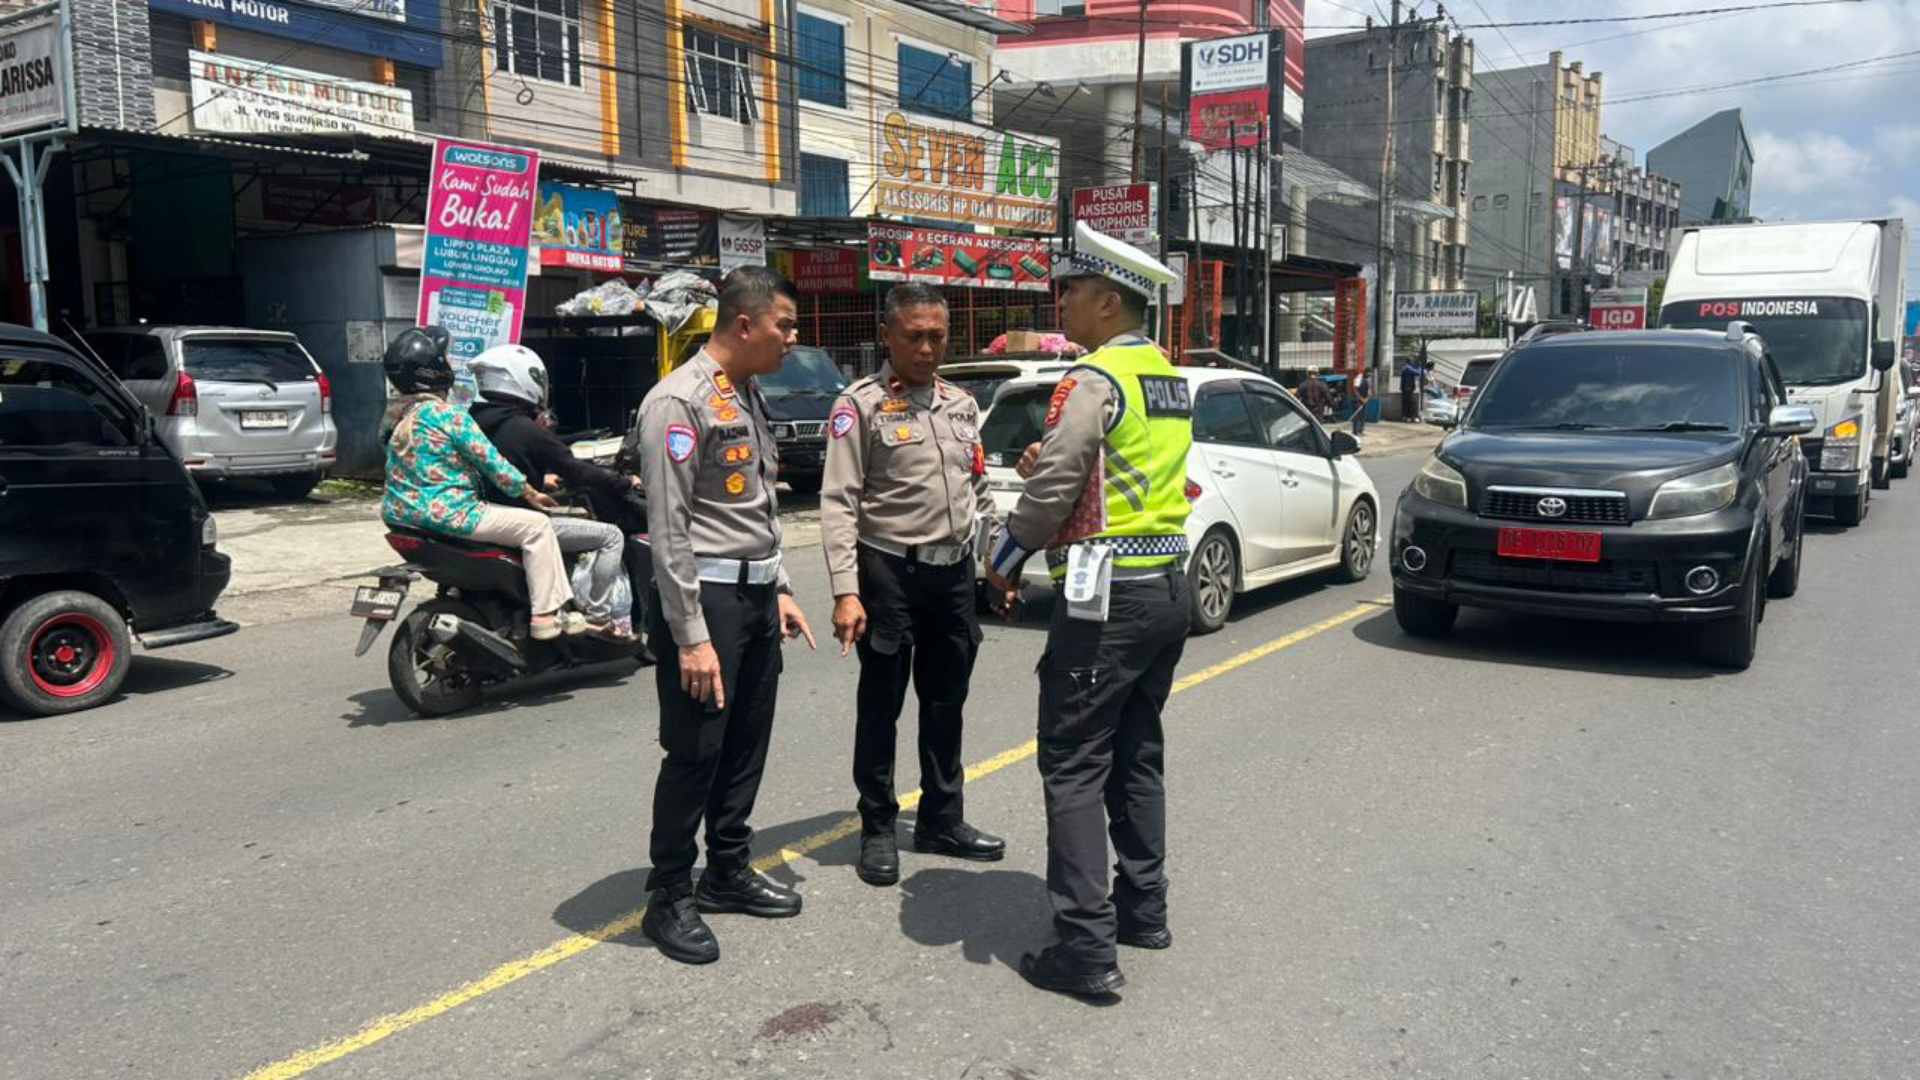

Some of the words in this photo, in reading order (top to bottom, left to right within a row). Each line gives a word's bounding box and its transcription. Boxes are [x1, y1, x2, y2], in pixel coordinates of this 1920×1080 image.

[231, 0, 289, 24] MOTOR
[1218, 42, 1263, 64] SDH
[883, 112, 986, 191] SEVEN
[996, 132, 1054, 200] ACC
[439, 168, 480, 192] Kami
[481, 174, 530, 200] Sudah
[885, 190, 949, 212] AKSESORIS
[953, 198, 967, 214] HP
[1092, 187, 1129, 201] PUSAT
[440, 193, 519, 231] Buka!
[1078, 200, 1145, 217] AKSESORIS
[1088, 214, 1148, 229] NDPHONE
[868, 227, 914, 241] GROSIR
[927, 232, 973, 248] ECERAN
[476, 242, 511, 256] PLAZA
[471, 251, 519, 267] LINGGAU
[1601, 309, 1635, 324] IGD
[1699, 302, 1739, 317] POS
[1741, 301, 1819, 316] INDONESIA
